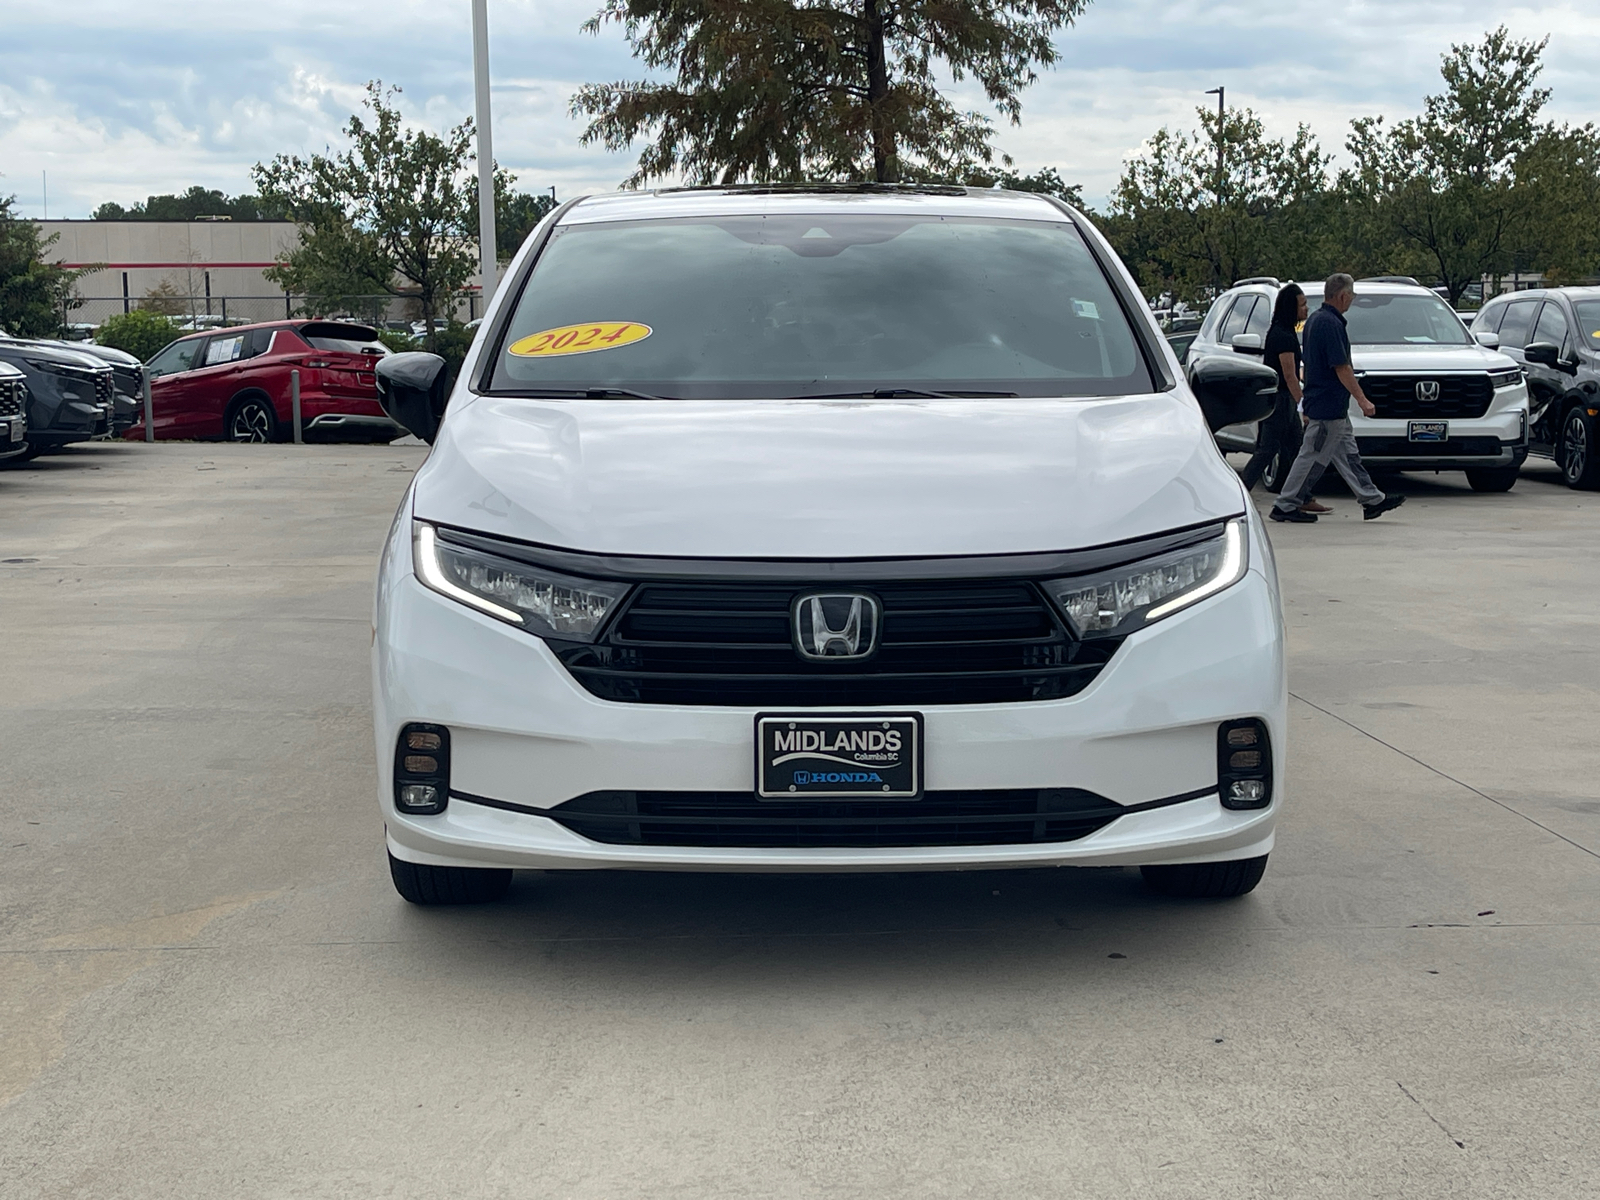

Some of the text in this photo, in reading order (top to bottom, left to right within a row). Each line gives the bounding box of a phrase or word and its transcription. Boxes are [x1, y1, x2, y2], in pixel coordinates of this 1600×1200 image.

[525, 324, 632, 353] 2024
[774, 730, 902, 751] MIDLANDS
[854, 752, 899, 761] Columbia SC
[811, 772, 883, 783] HONDA
